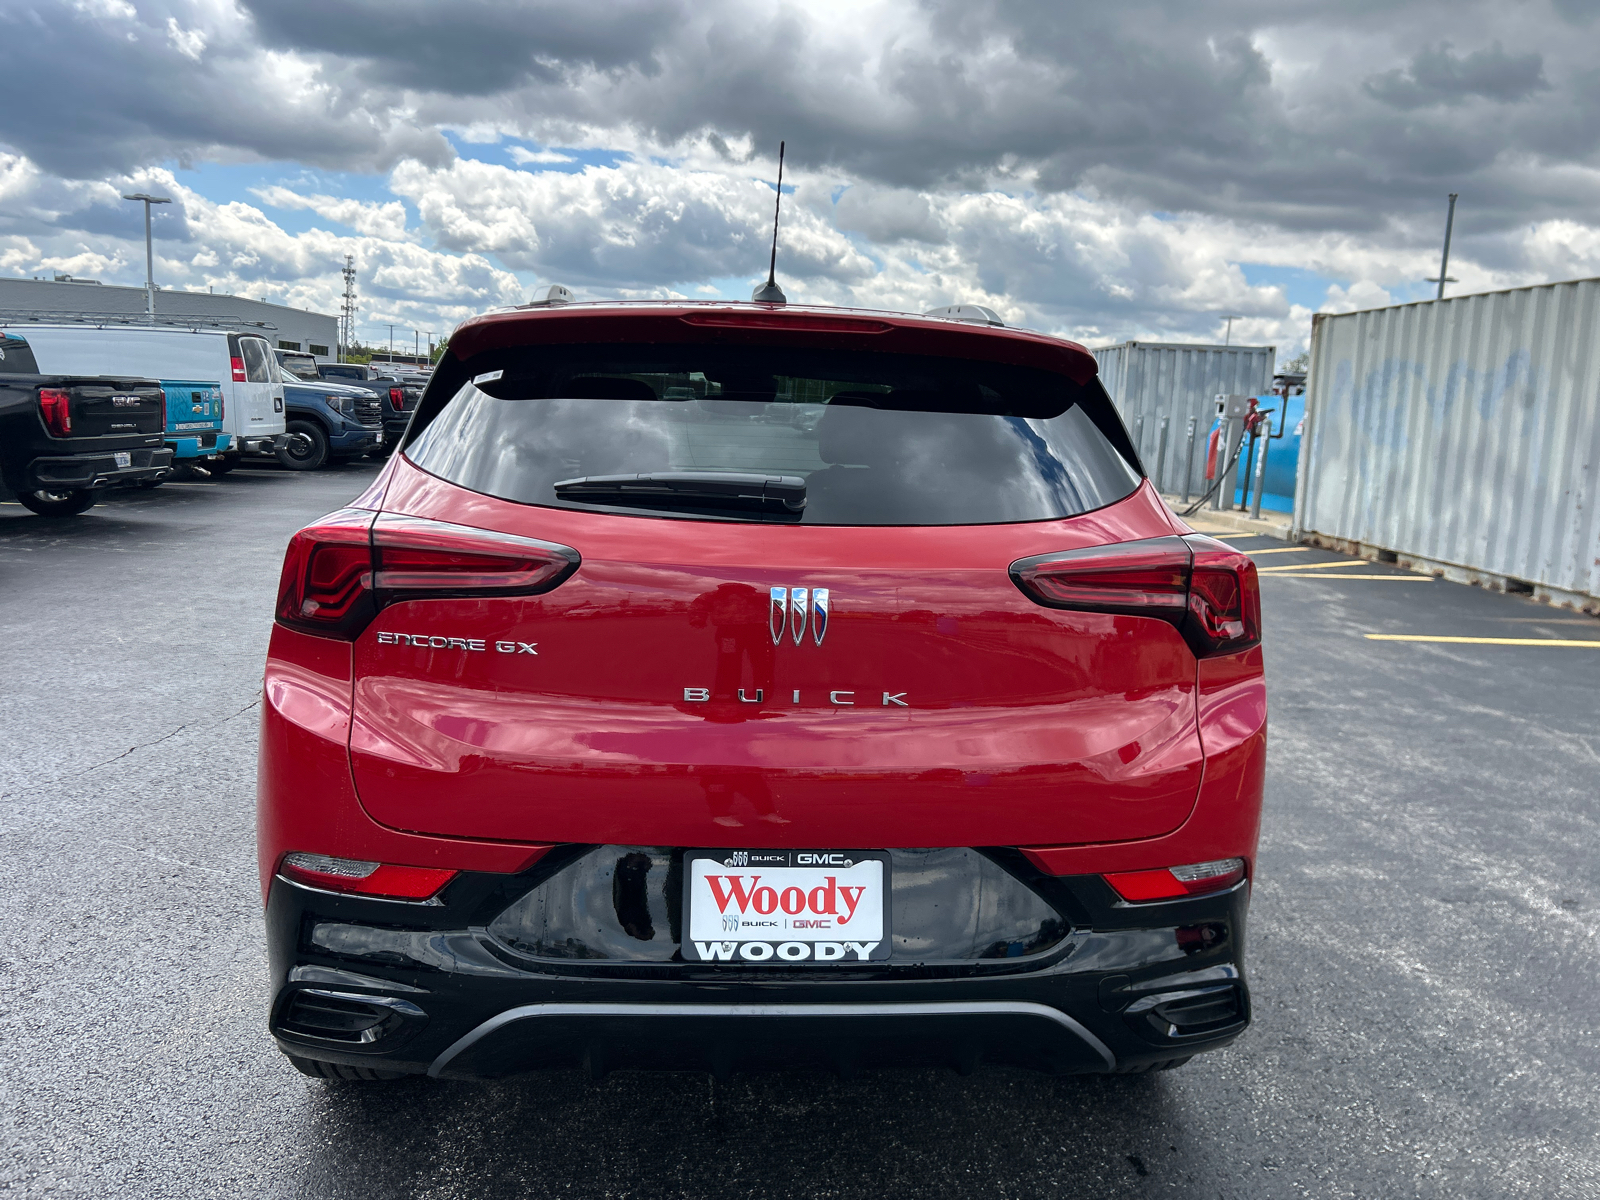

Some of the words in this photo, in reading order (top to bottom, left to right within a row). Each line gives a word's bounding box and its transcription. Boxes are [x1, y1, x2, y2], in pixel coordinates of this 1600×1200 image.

[376, 631, 486, 651] ENCORE
[495, 640, 539, 655] GX
[683, 687, 909, 706] BUICK
[797, 853, 844, 865] GMC
[704, 875, 866, 925] Woody
[793, 919, 831, 929] GMC
[694, 941, 880, 961] WOODY
